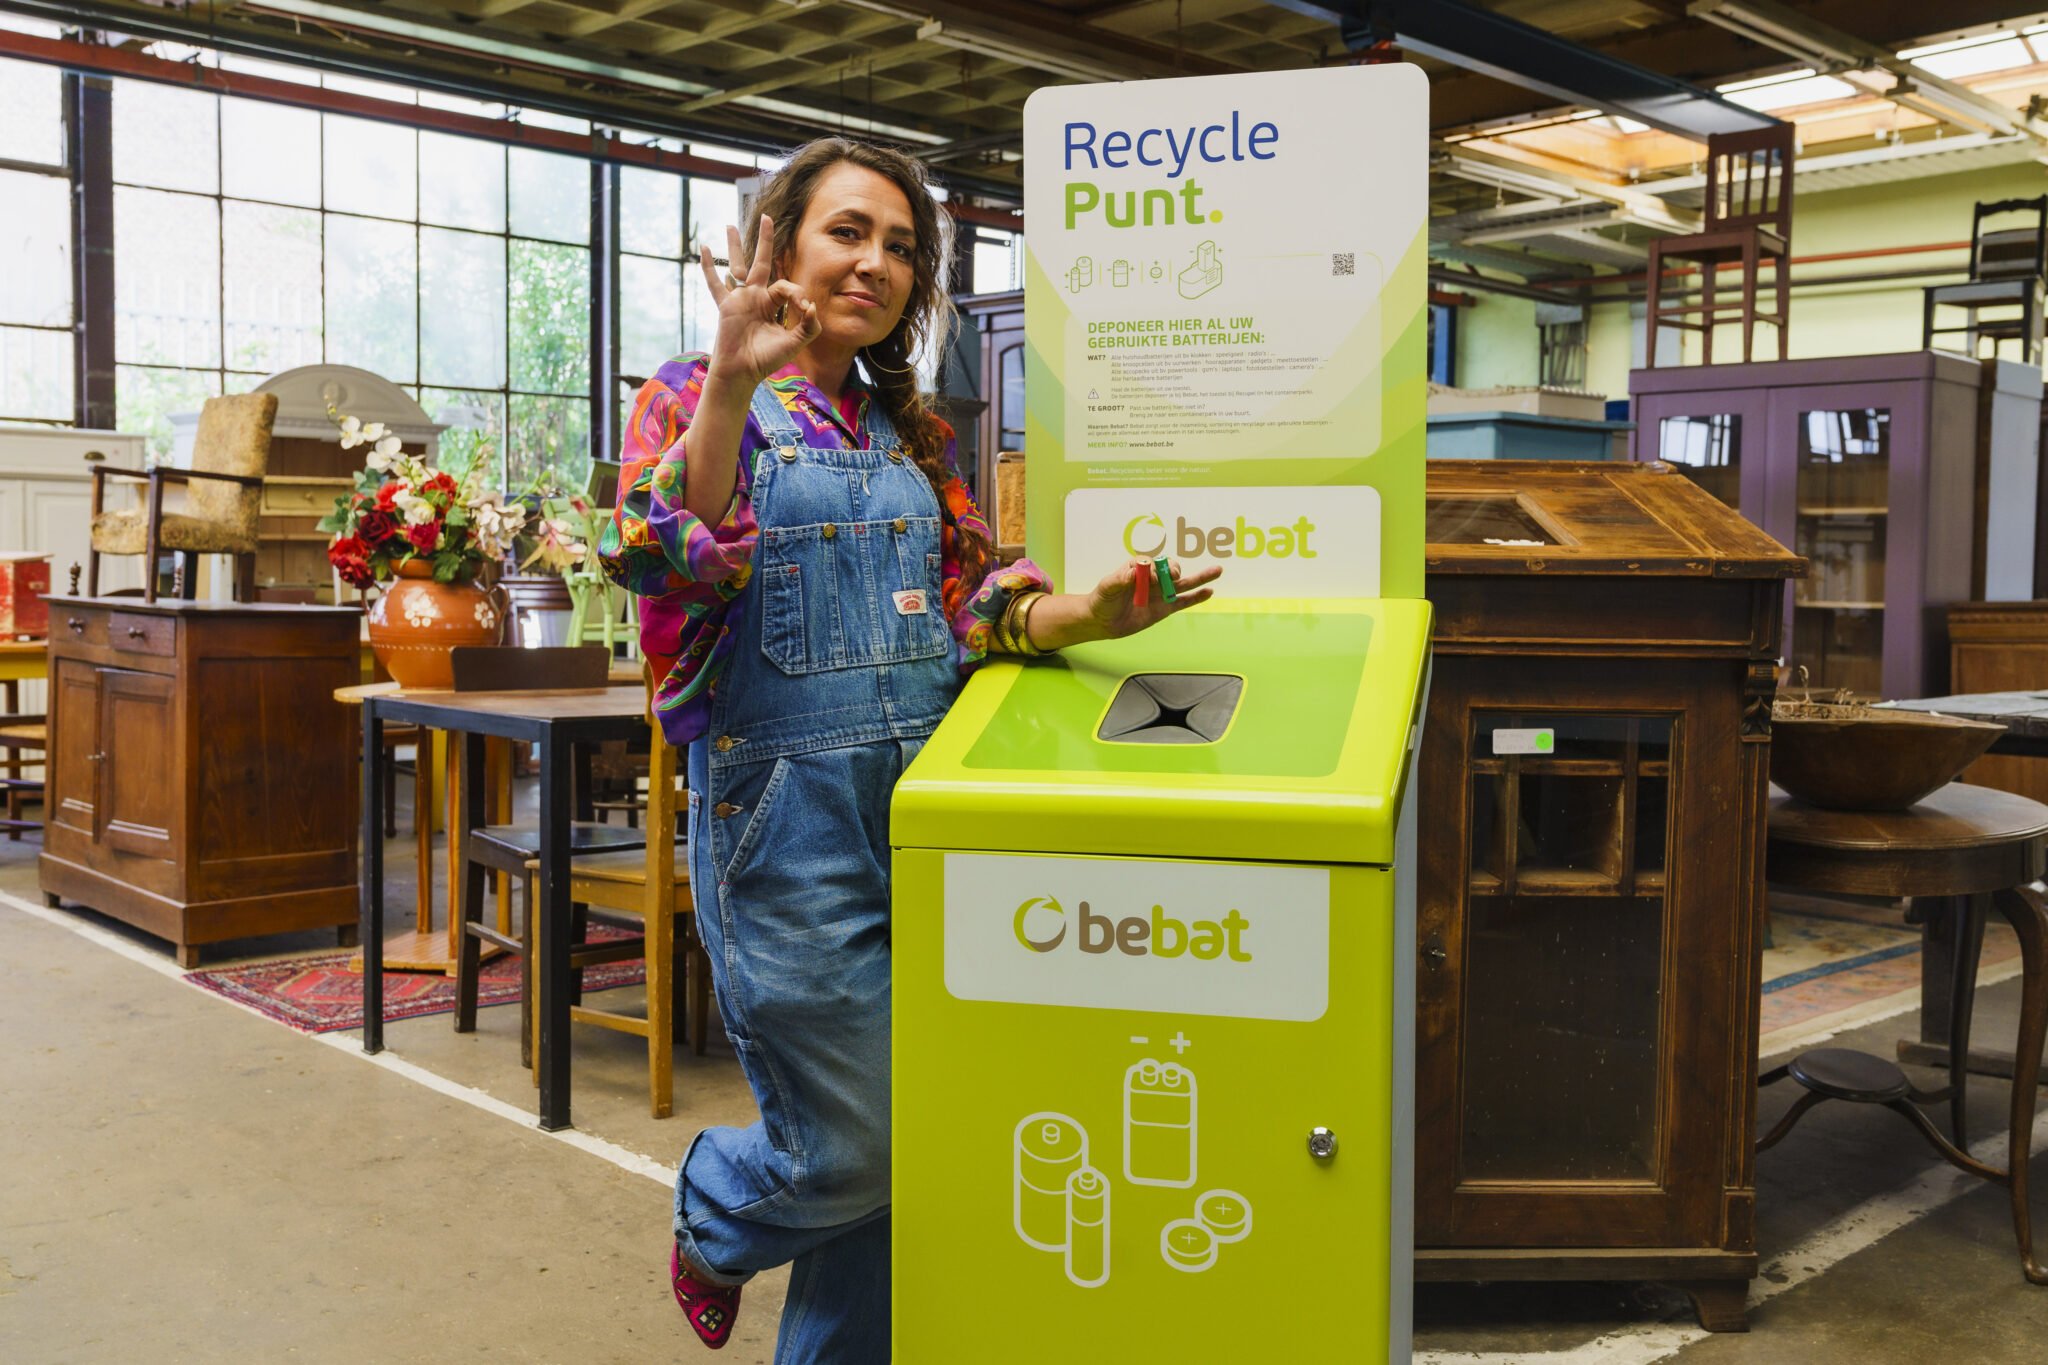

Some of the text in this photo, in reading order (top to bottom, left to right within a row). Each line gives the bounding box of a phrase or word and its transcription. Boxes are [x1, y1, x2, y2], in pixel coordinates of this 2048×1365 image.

[1065, 110, 1279, 178] Recycle
[1065, 178, 1223, 230] Punt.
[1088, 317, 1253, 333] DEPONEER HIER AL UW
[1088, 332, 1265, 348] GEBRUIKTE BATTERIJEN:
[1176, 516, 1317, 559] bebat
[1078, 901, 1252, 962] bebat
